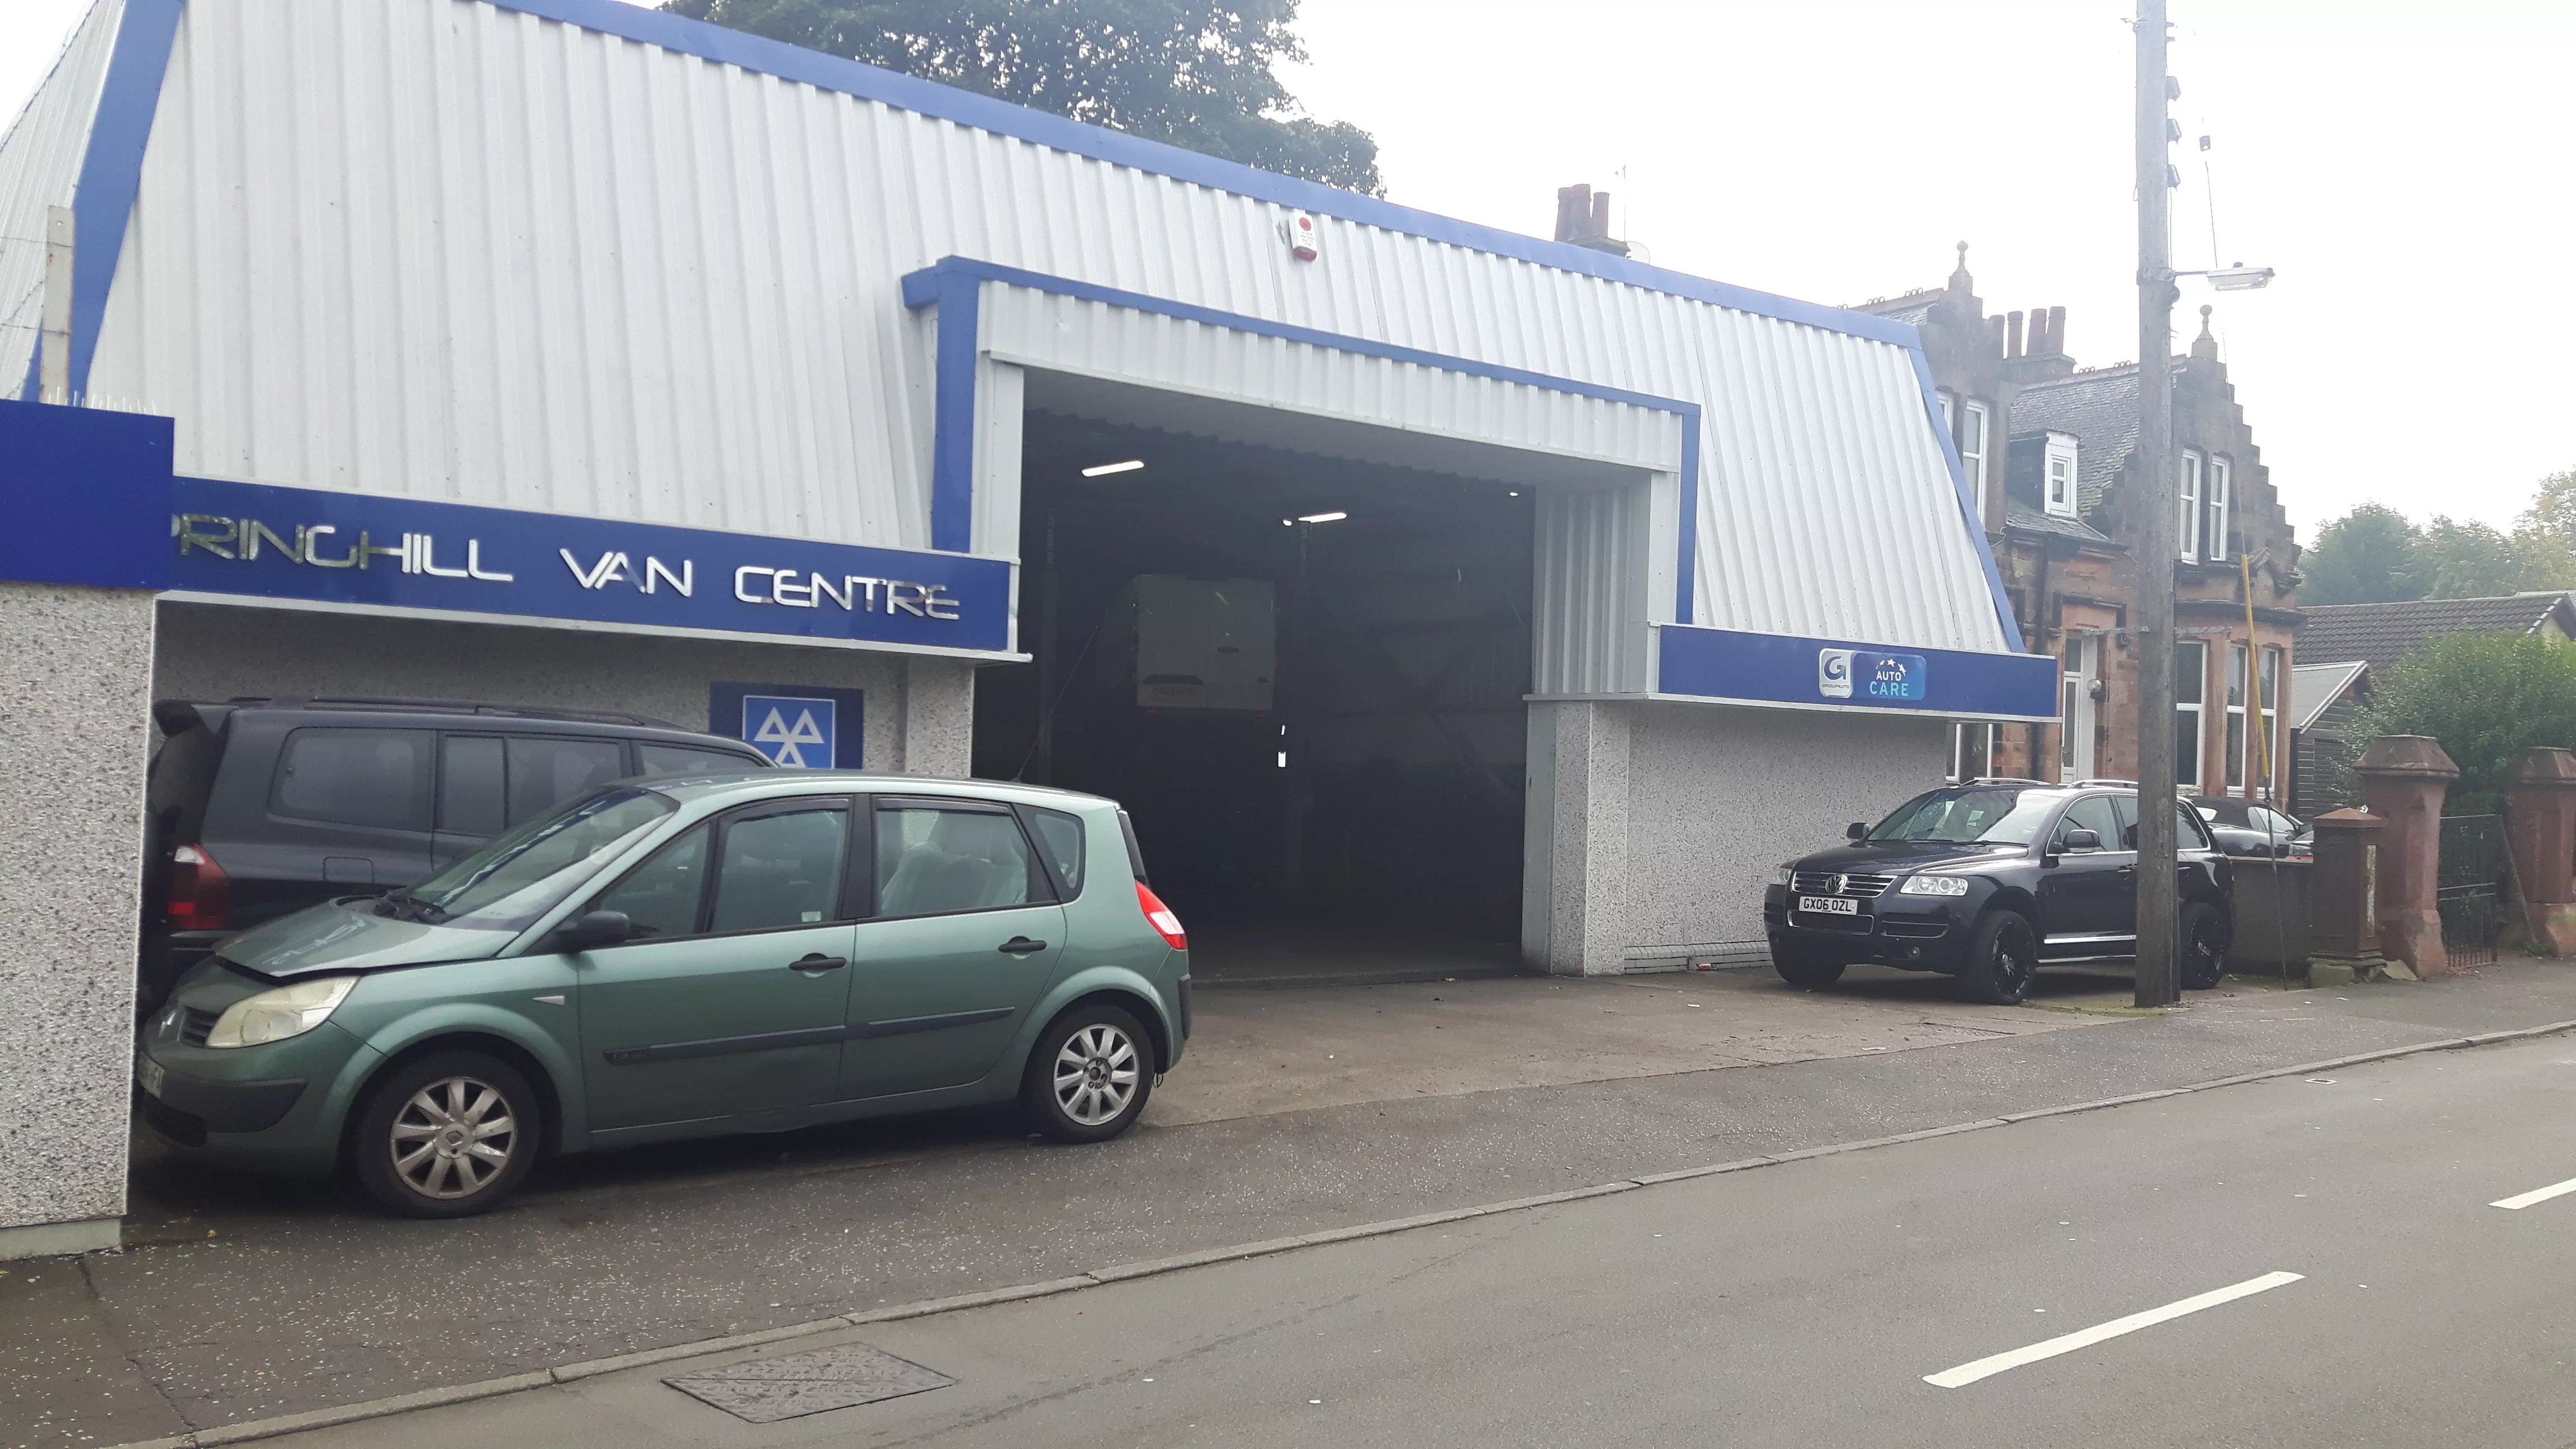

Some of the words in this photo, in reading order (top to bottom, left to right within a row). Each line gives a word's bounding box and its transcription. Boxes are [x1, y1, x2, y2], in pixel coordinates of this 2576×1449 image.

[171, 513, 514, 581] RINGHILL
[559, 547, 692, 597] VAN
[734, 565, 960, 620] CENTRE
[1876, 670, 1902, 681] AUTO
[1869, 680, 1909, 697] CARE
[1803, 898, 1829, 910] GX06
[1831, 899, 1852, 912] OZL
